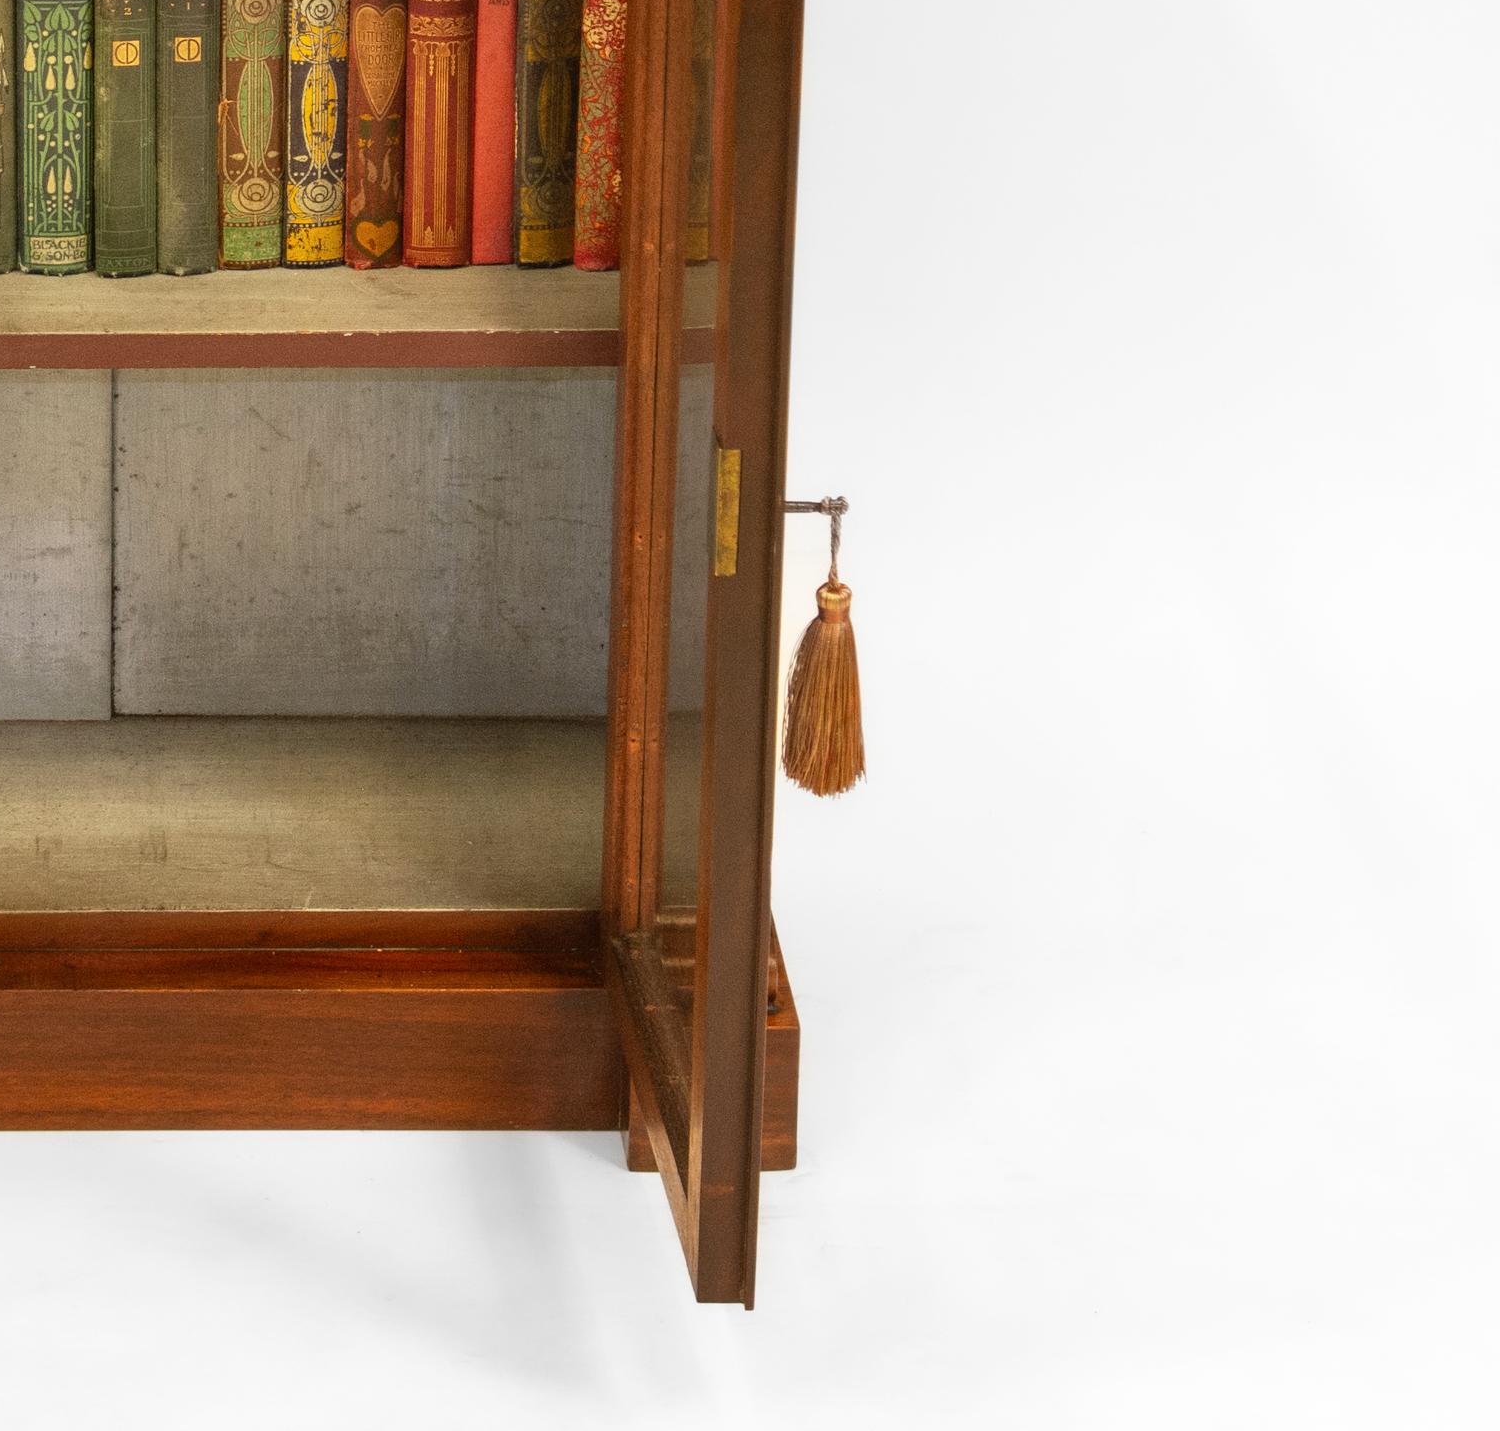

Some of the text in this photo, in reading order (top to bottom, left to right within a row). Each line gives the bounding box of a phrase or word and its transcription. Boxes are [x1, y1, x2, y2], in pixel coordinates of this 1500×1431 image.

[123, 7, 132, 16] 2
[357, 31, 387, 44] LITTLE
[367, 54, 397, 66] DOOR
[32, 238, 86, 250] BLACKIE
